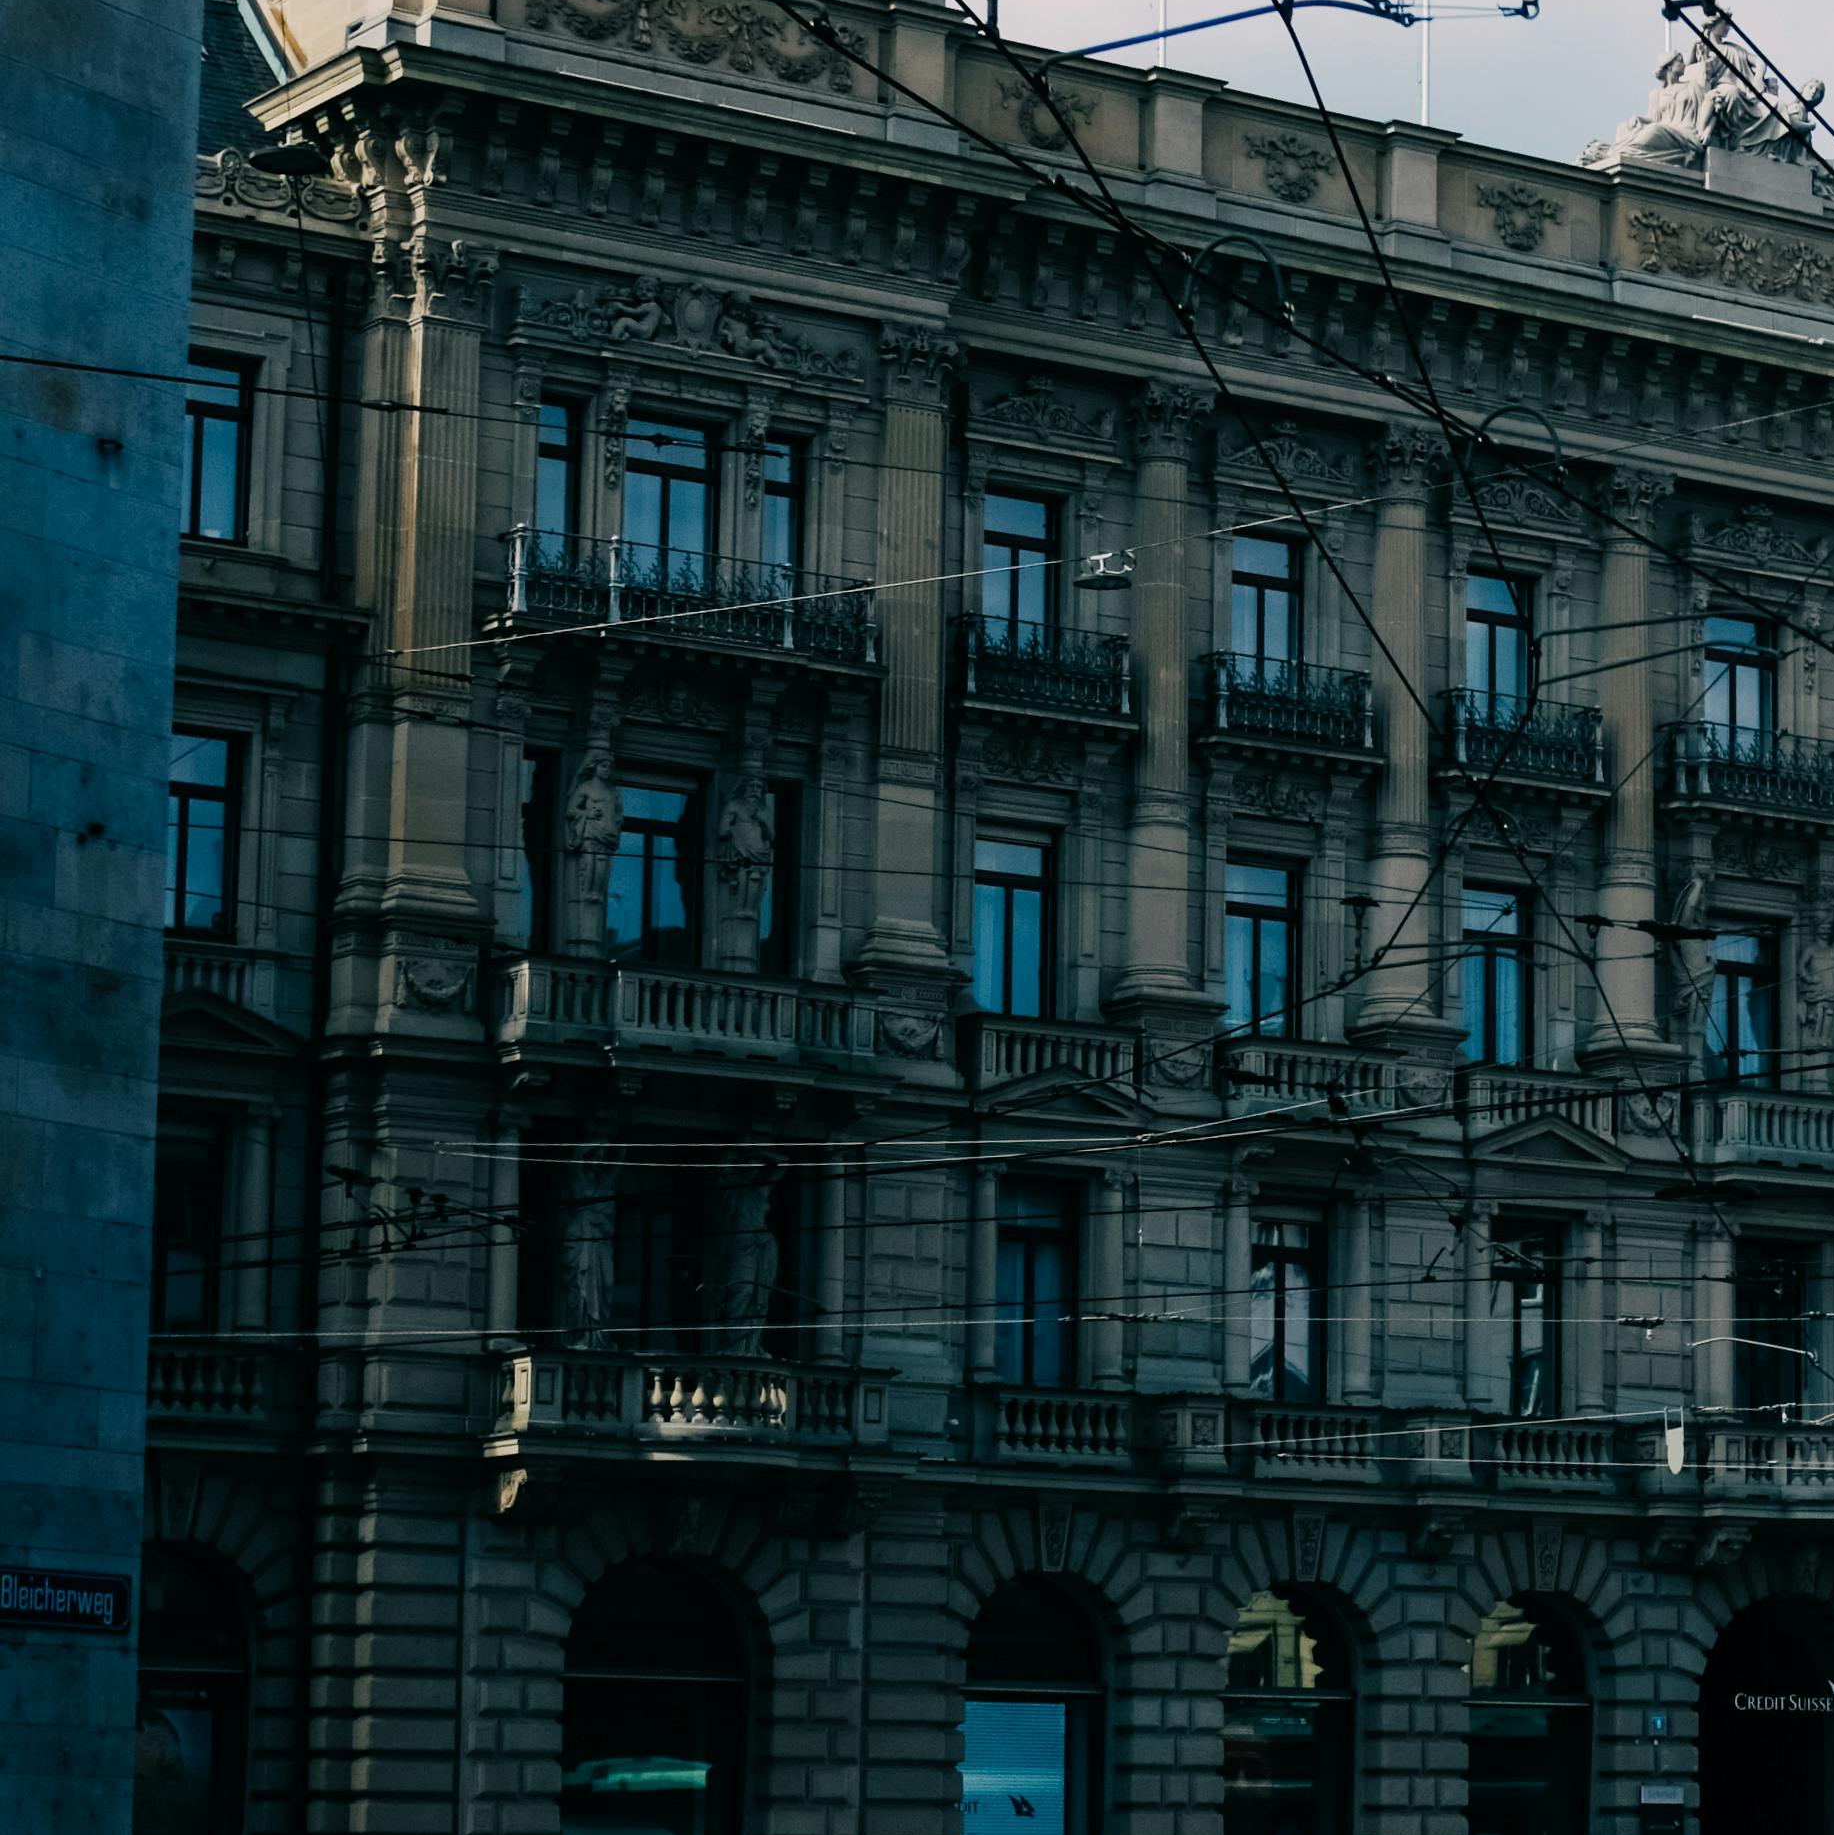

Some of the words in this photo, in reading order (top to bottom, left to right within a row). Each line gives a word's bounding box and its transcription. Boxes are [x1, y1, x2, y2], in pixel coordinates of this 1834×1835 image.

[1, 1573, 114, 1625] Bleicherweg
[1735, 1692, 1787, 1711] CREDIT
[1788, 1693, 1834, 1712] SUISSE
